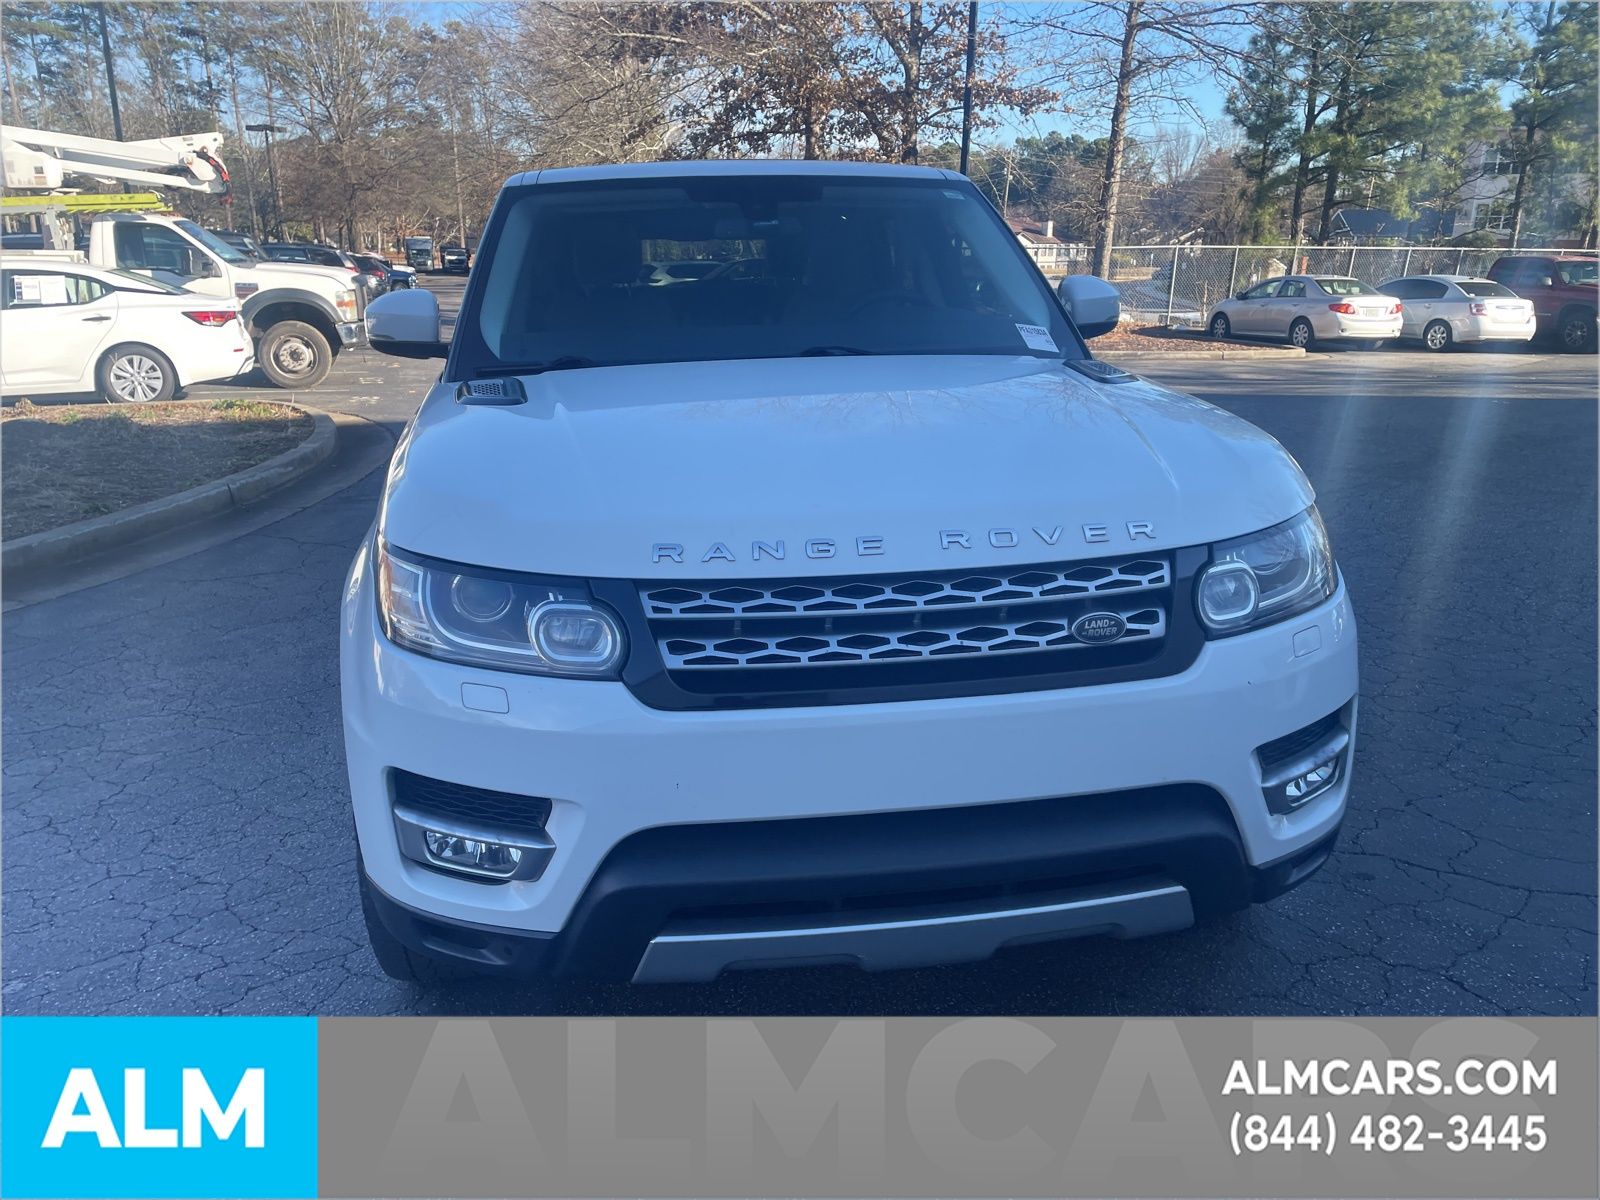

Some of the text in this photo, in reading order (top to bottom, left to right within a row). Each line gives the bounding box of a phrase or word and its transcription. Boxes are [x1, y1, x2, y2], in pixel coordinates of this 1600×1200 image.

[652, 521, 1156, 563] RANGE ROVER
[1084, 619, 1110, 629] LAND
[1087, 627, 1118, 637] ROVER
